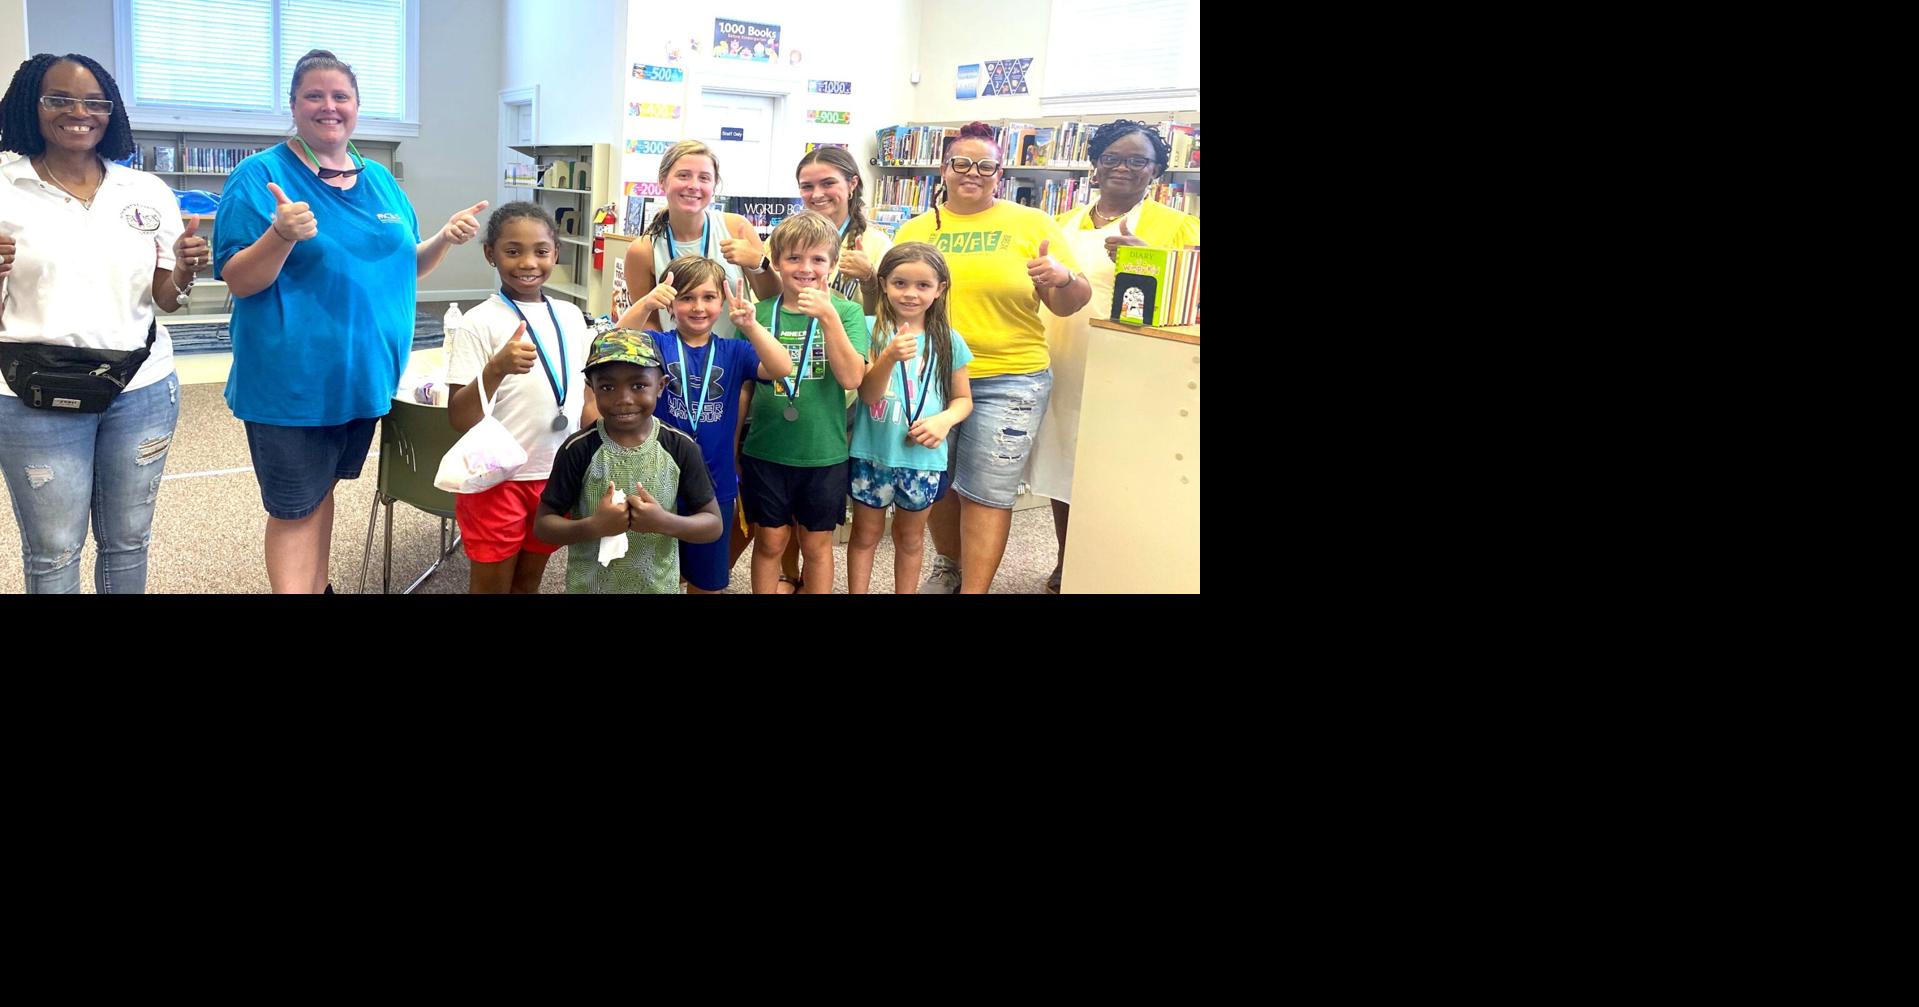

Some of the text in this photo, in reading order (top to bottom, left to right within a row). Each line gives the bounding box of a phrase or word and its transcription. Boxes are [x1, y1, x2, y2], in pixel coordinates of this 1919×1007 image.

[719, 22, 777, 39] 1000 Books
[651, 67, 672, 81] 500
[643, 141, 664, 154] 300
[744, 203, 785, 215] WORLD
